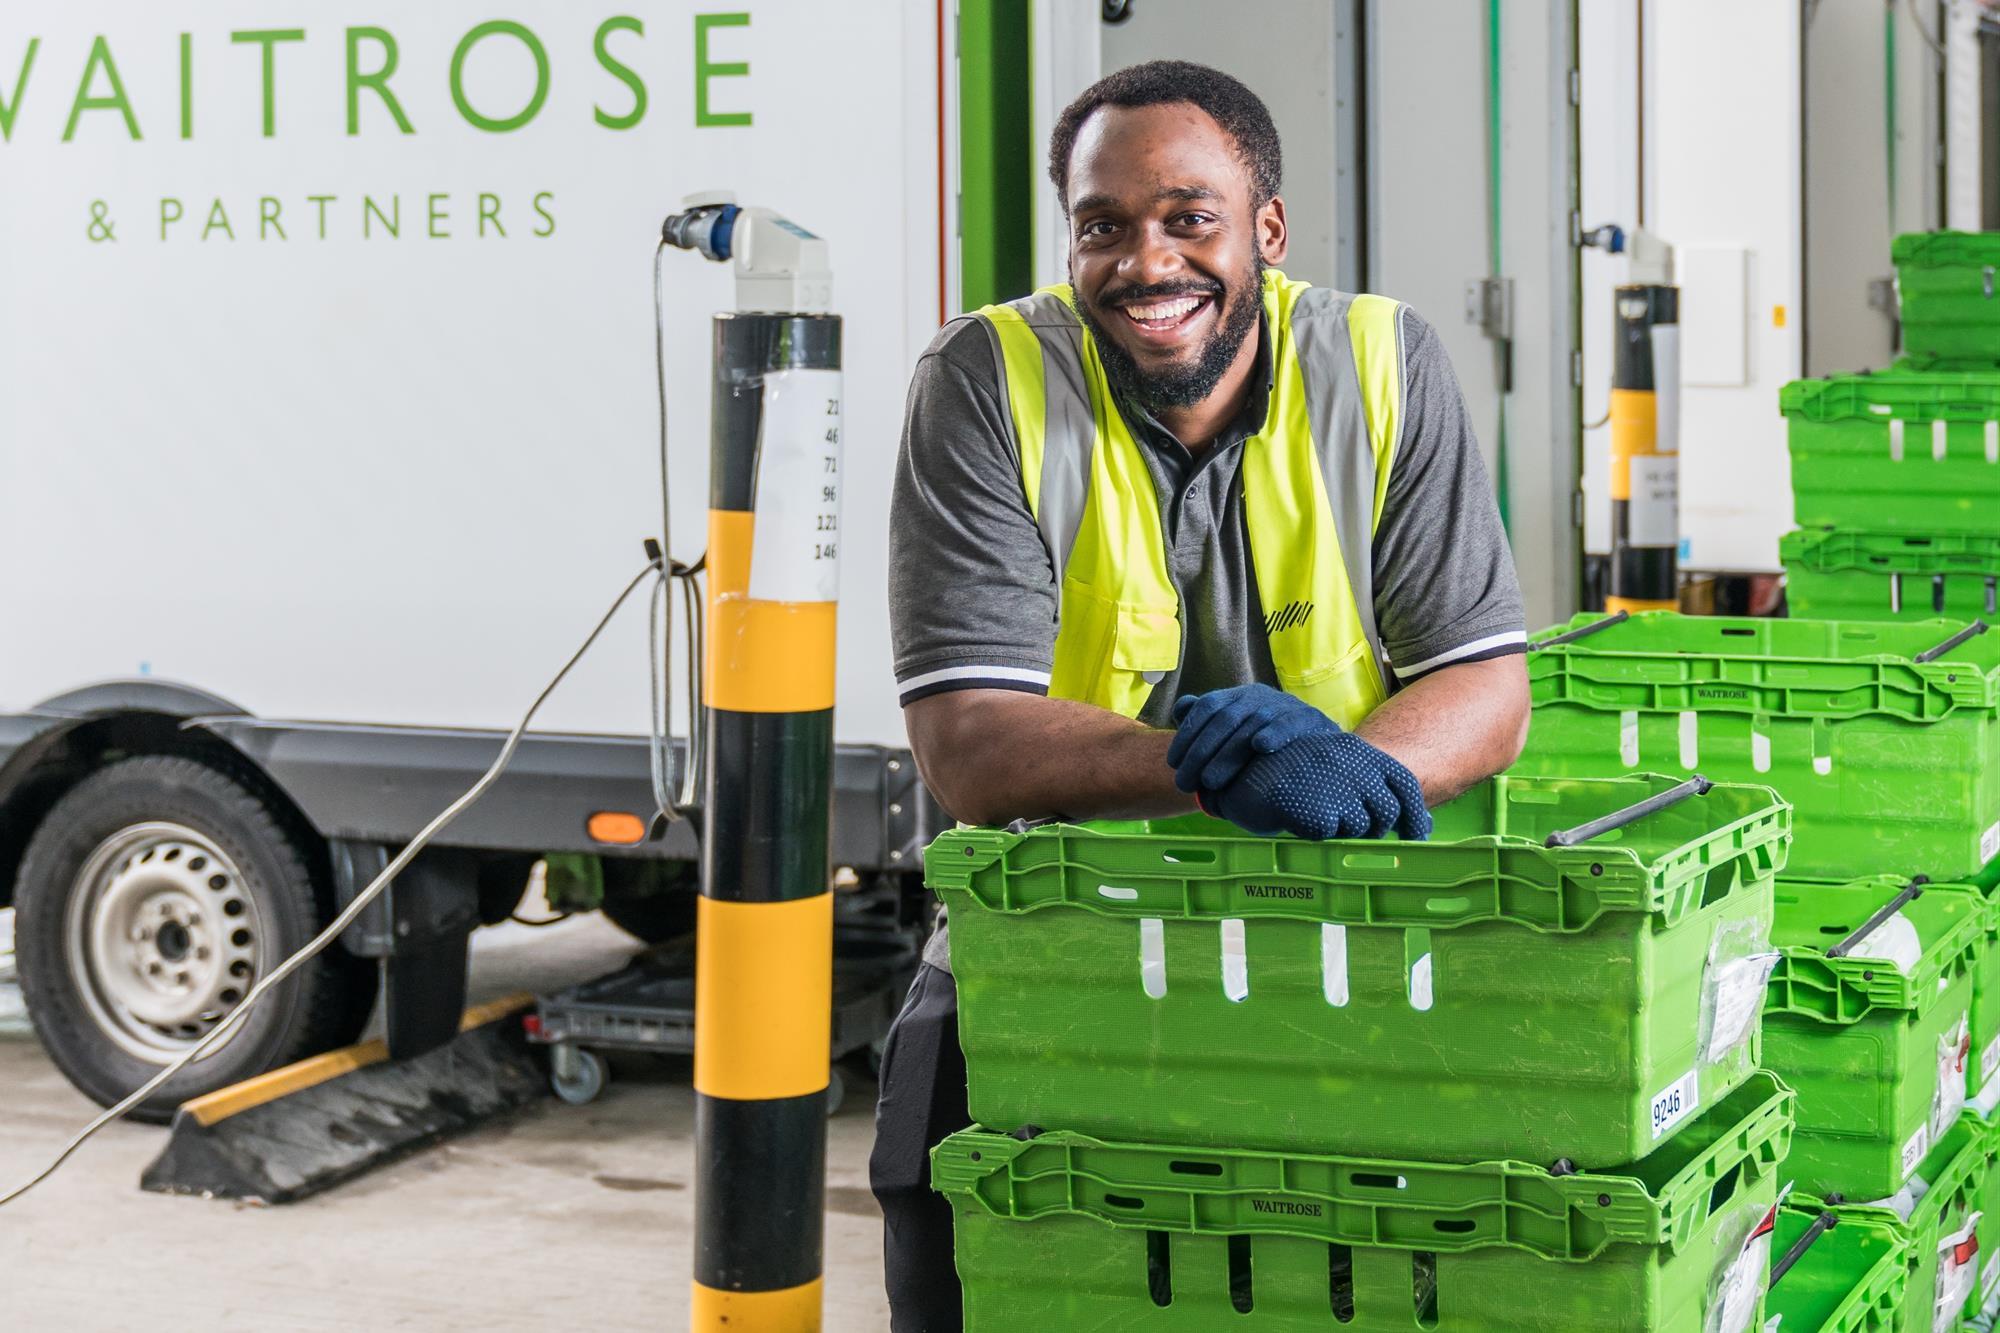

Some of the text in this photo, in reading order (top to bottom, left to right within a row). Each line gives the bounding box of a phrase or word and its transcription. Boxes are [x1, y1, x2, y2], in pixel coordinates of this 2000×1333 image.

[87, 190, 558, 243] & PARTNERS
[827, 399, 840, 416] 21
[825, 428, 839, 444] 46
[824, 457, 837, 474] 71
[823, 486, 837, 502] 96
[817, 515, 837, 532] 121
[816, 544, 837, 560] 146
[1697, 688, 1748, 699] WAITROSE
[1244, 884, 1314, 900] WAITROSE
[1653, 1089, 1680, 1128] 9246
[1252, 1199, 1322, 1217] WAITROSE
